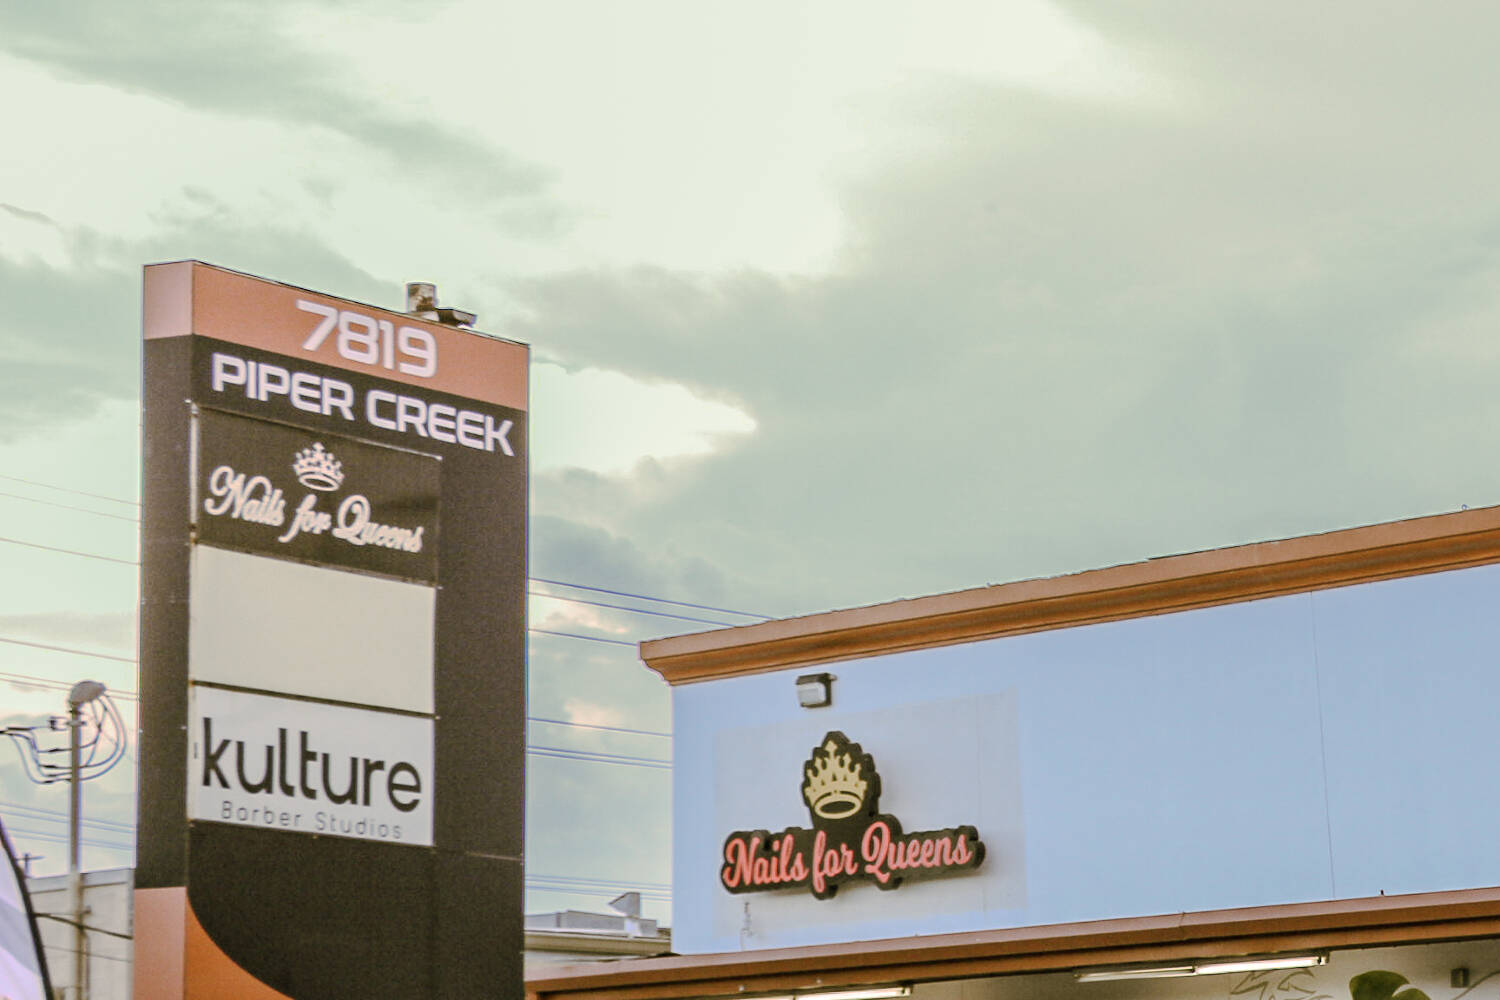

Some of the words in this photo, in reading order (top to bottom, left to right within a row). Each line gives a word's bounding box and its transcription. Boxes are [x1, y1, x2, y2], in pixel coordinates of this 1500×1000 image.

[296, 299, 437, 378] 7819
[211, 352, 355, 421] PIPER
[366, 390, 515, 456] CREEK
[204, 466, 286, 527] Nails
[278, 494, 332, 544] for
[332, 495, 424, 553] Queens
[202, 717, 422, 812] kulture
[221, 801, 301, 827] Barber
[315, 812, 403, 839] Studios
[722, 834, 810, 888] Nails
[812, 830, 858, 893] for
[861, 821, 973, 883] Queens
